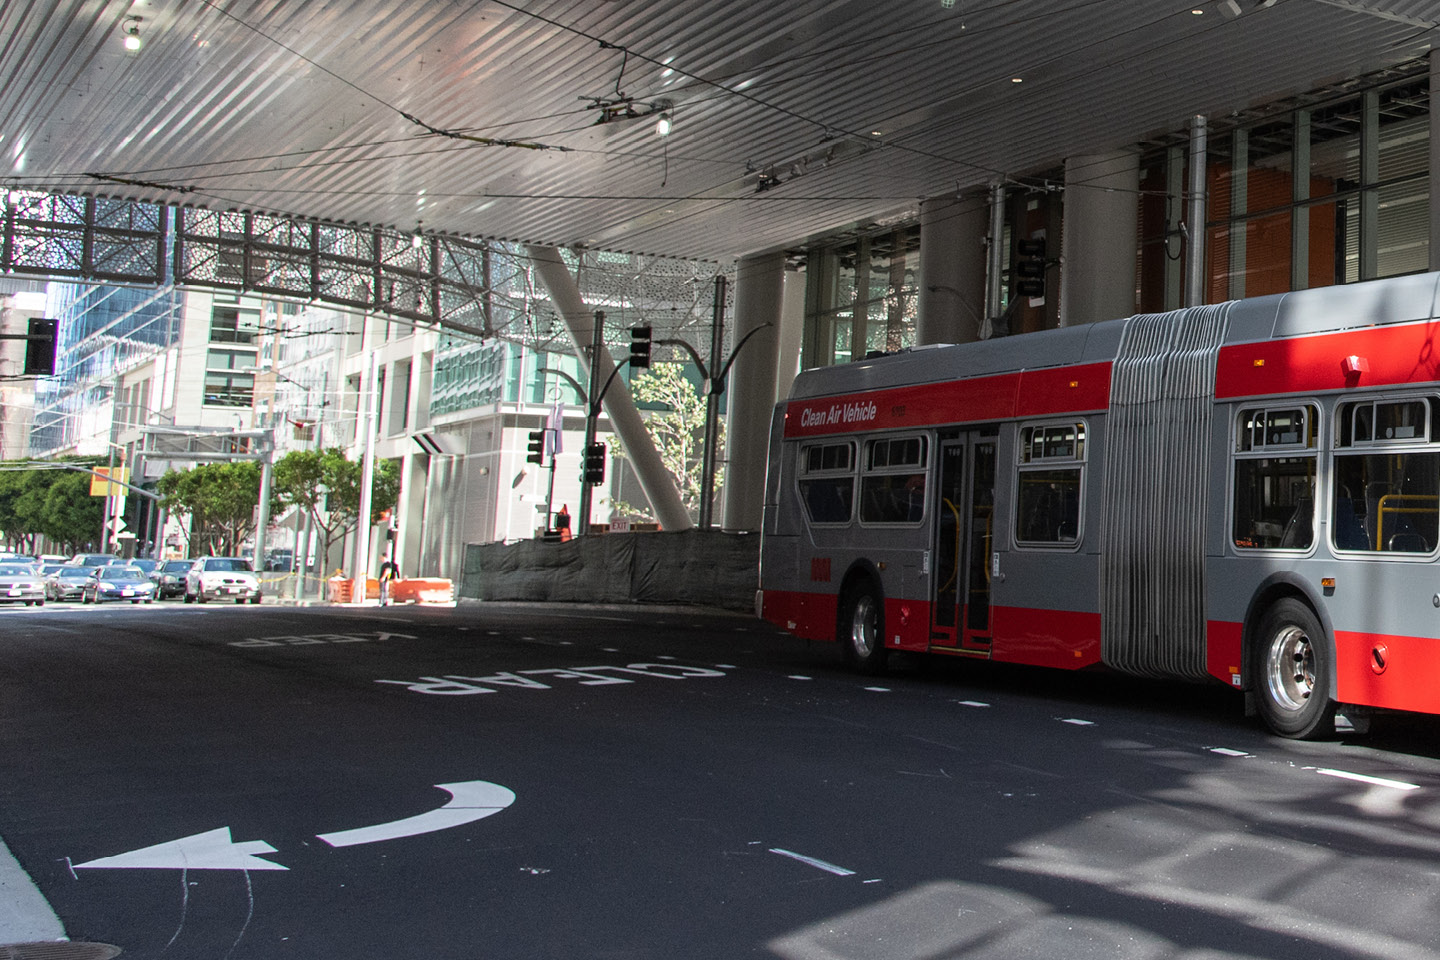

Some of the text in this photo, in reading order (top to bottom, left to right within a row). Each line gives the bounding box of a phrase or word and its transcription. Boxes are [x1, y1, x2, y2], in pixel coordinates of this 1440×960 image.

[801, 401, 877, 427] Clean Air Vehicle
[612, 521, 627, 530] EXIT
[375, 663, 727, 695] CLEAR
